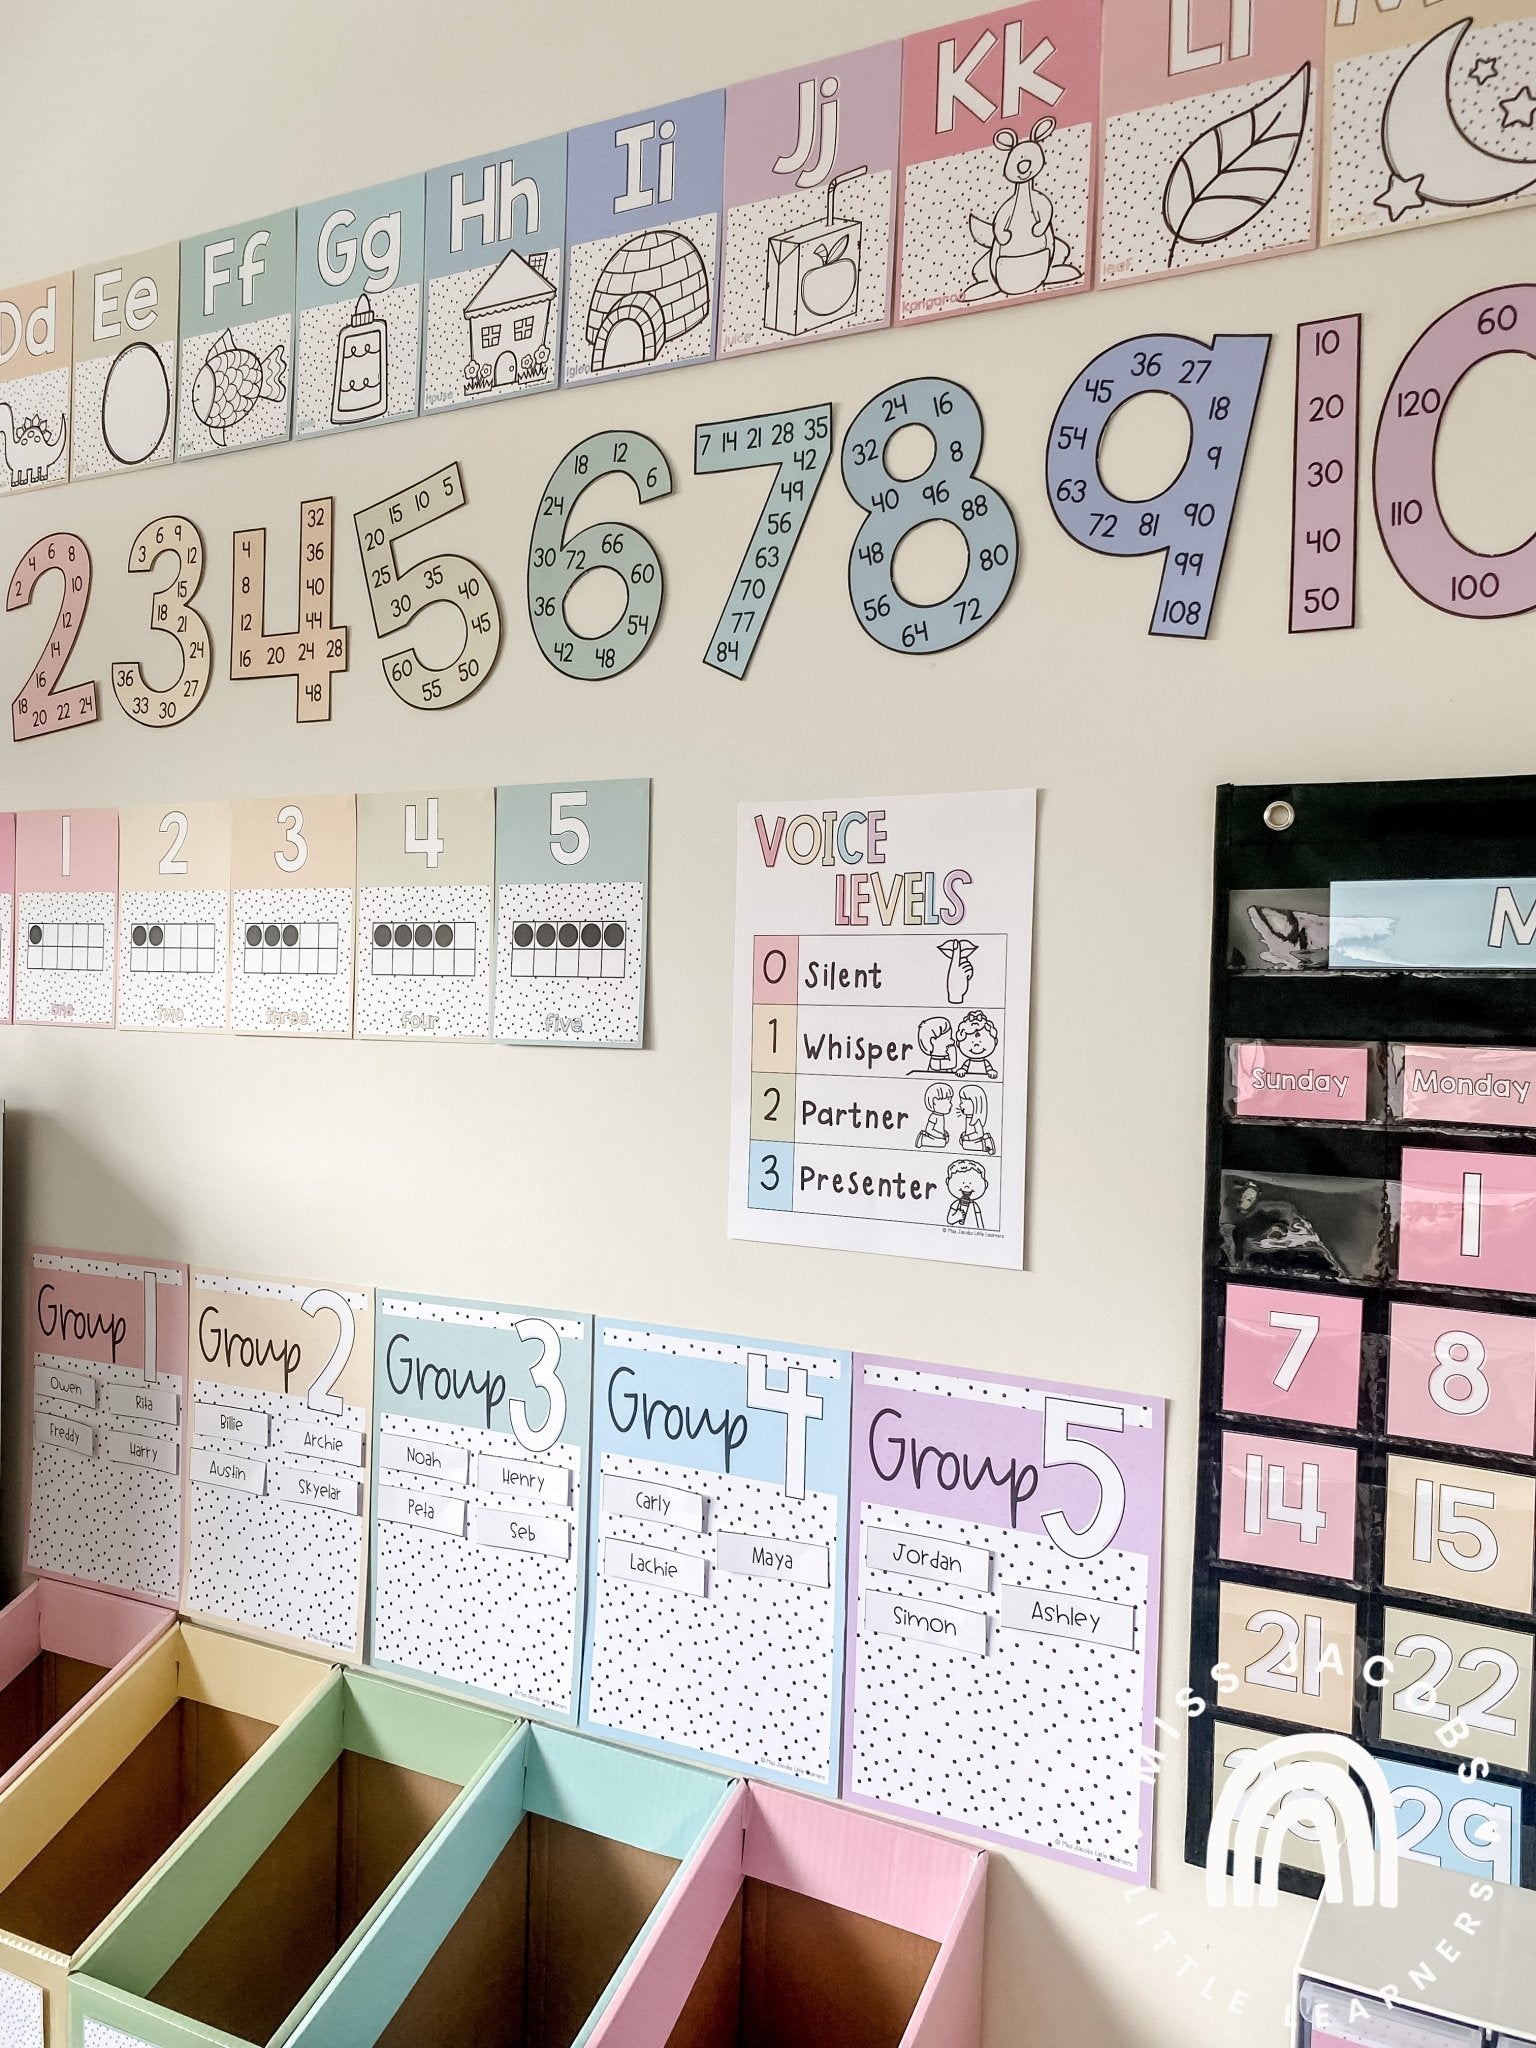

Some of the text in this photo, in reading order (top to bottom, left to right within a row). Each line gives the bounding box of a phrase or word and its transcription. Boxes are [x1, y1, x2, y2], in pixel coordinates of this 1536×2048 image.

[934, 19, 1066, 135] Kk
[771, 75, 840, 189] Jj
[613, 119, 676, 214] Ii
[449, 159, 540, 253] Hh
[316, 209, 402, 294] Gg
[203, 230, 272, 316] Ff
[92, 267, 159, 341] Ee
[1477, 304, 1518, 335] 60
[1315, 329, 1340, 357] 10
[1130, 351, 1213, 385] 36 27
[1085, 378, 1115, 404] 45
[1397, 387, 1441, 418] 120
[881, 391, 954, 423] 24 16
[1208, 396, 1231, 421] 18
[1308, 393, 1344, 423] 20
[699, 415, 828, 456] 7 14 21 28 35
[1057, 425, 1088, 451] 54
[574, 454, 589, 475] 18
[613, 442, 628, 463] 12
[793, 448, 817, 471] 42
[851, 438, 879, 466] 32
[949, 440, 964, 463] 8
[1207, 446, 1223, 471] 9
[646, 466, 658, 488] 6
[1307, 459, 1344, 488] 30
[388, 476, 454, 525] 15 10 5
[780, 480, 804, 503] 49
[1056, 478, 1087, 504] 63
[307, 507, 325, 528] 32
[961, 494, 988, 522] 88
[1183, 502, 1216, 528] 90
[1391, 499, 1423, 527] 110
[155, 524, 182, 544] 6 9
[767, 511, 792, 536] 56
[364, 528, 385, 552] 20
[601, 533, 624, 554] 66
[858, 541, 884, 567] 48
[1306, 527, 1341, 554] 40
[187, 546, 198, 565] 12
[755, 545, 780, 569] 63
[979, 543, 1009, 572] 80
[71, 575, 83, 594] 10
[241, 576, 251, 594] 8
[630, 563, 655, 584] 60
[1451, 572, 1500, 602] 100
[1162, 599, 1202, 626] 108
[1303, 586, 1340, 614] 50
[62, 611, 73, 629] 12
[471, 611, 491, 635] 45
[627, 614, 649, 636] 54
[239, 638, 343, 668] 16 20 24 28
[32, 695, 93, 728] 20 22 24
[273, 804, 309, 873] 3
[404, 798, 445, 869] 4
[549, 791, 591, 866] 5
[754, 810, 888, 867] VOICE
[61, 815, 71, 877] 1
[158, 811, 189, 875] 2
[834, 869, 973, 926] LEVELS
[762, 949, 882, 991] 0 Silent
[157, 1003, 185, 1022] two
[266, 1007, 310, 1026] three
[401, 1011, 440, 1030] four
[544, 1013, 583, 1033] five
[769, 1018, 913, 1072] 1 Whisper
[1251, 1066, 1350, 1098] Sunday
[1412, 1069, 1531, 1104] Monday
[763, 1086, 908, 1129] 2 Partner
[760, 1154, 937, 1201] 3 Presenter
[1460, 1171, 1483, 1258] 1
[38, 1283, 127, 1363] Group
[199, 1289, 356, 1417] Group 2
[1268, 1310, 1321, 1392] 7
[50, 1376, 82, 1395] Owen
[386, 1317, 568, 1454] Group 3
[1428, 1329, 1490, 1417] 8
[135, 1395, 153, 1411] Rita
[50, 1423, 79, 1445] Freddy
[607, 1352, 824, 1501] Group 4
[130, 1442, 158, 1462] Harry
[304, 1431, 343, 1451] Archie
[209, 1460, 246, 1481] Austin
[407, 1446, 442, 1468] Noah
[502, 1468, 545, 1492] Henry
[868, 1396, 1127, 1559] Group 5
[636, 1491, 671, 1516] Carly
[1242, 1453, 1327, 1544] 14
[509, 1521, 536, 1541] Seb
[1412, 1478, 1499, 1573] 15
[630, 1552, 678, 1578] Lachie
[752, 1547, 793, 1571] Maya
[892, 1543, 962, 1573] Jordan
[893, 1606, 957, 1636] Simon
[1031, 1601, 1100, 1633] Ashley
[1243, 1608, 1325, 1698] 21
[1391, 1633, 1520, 1738] 22
